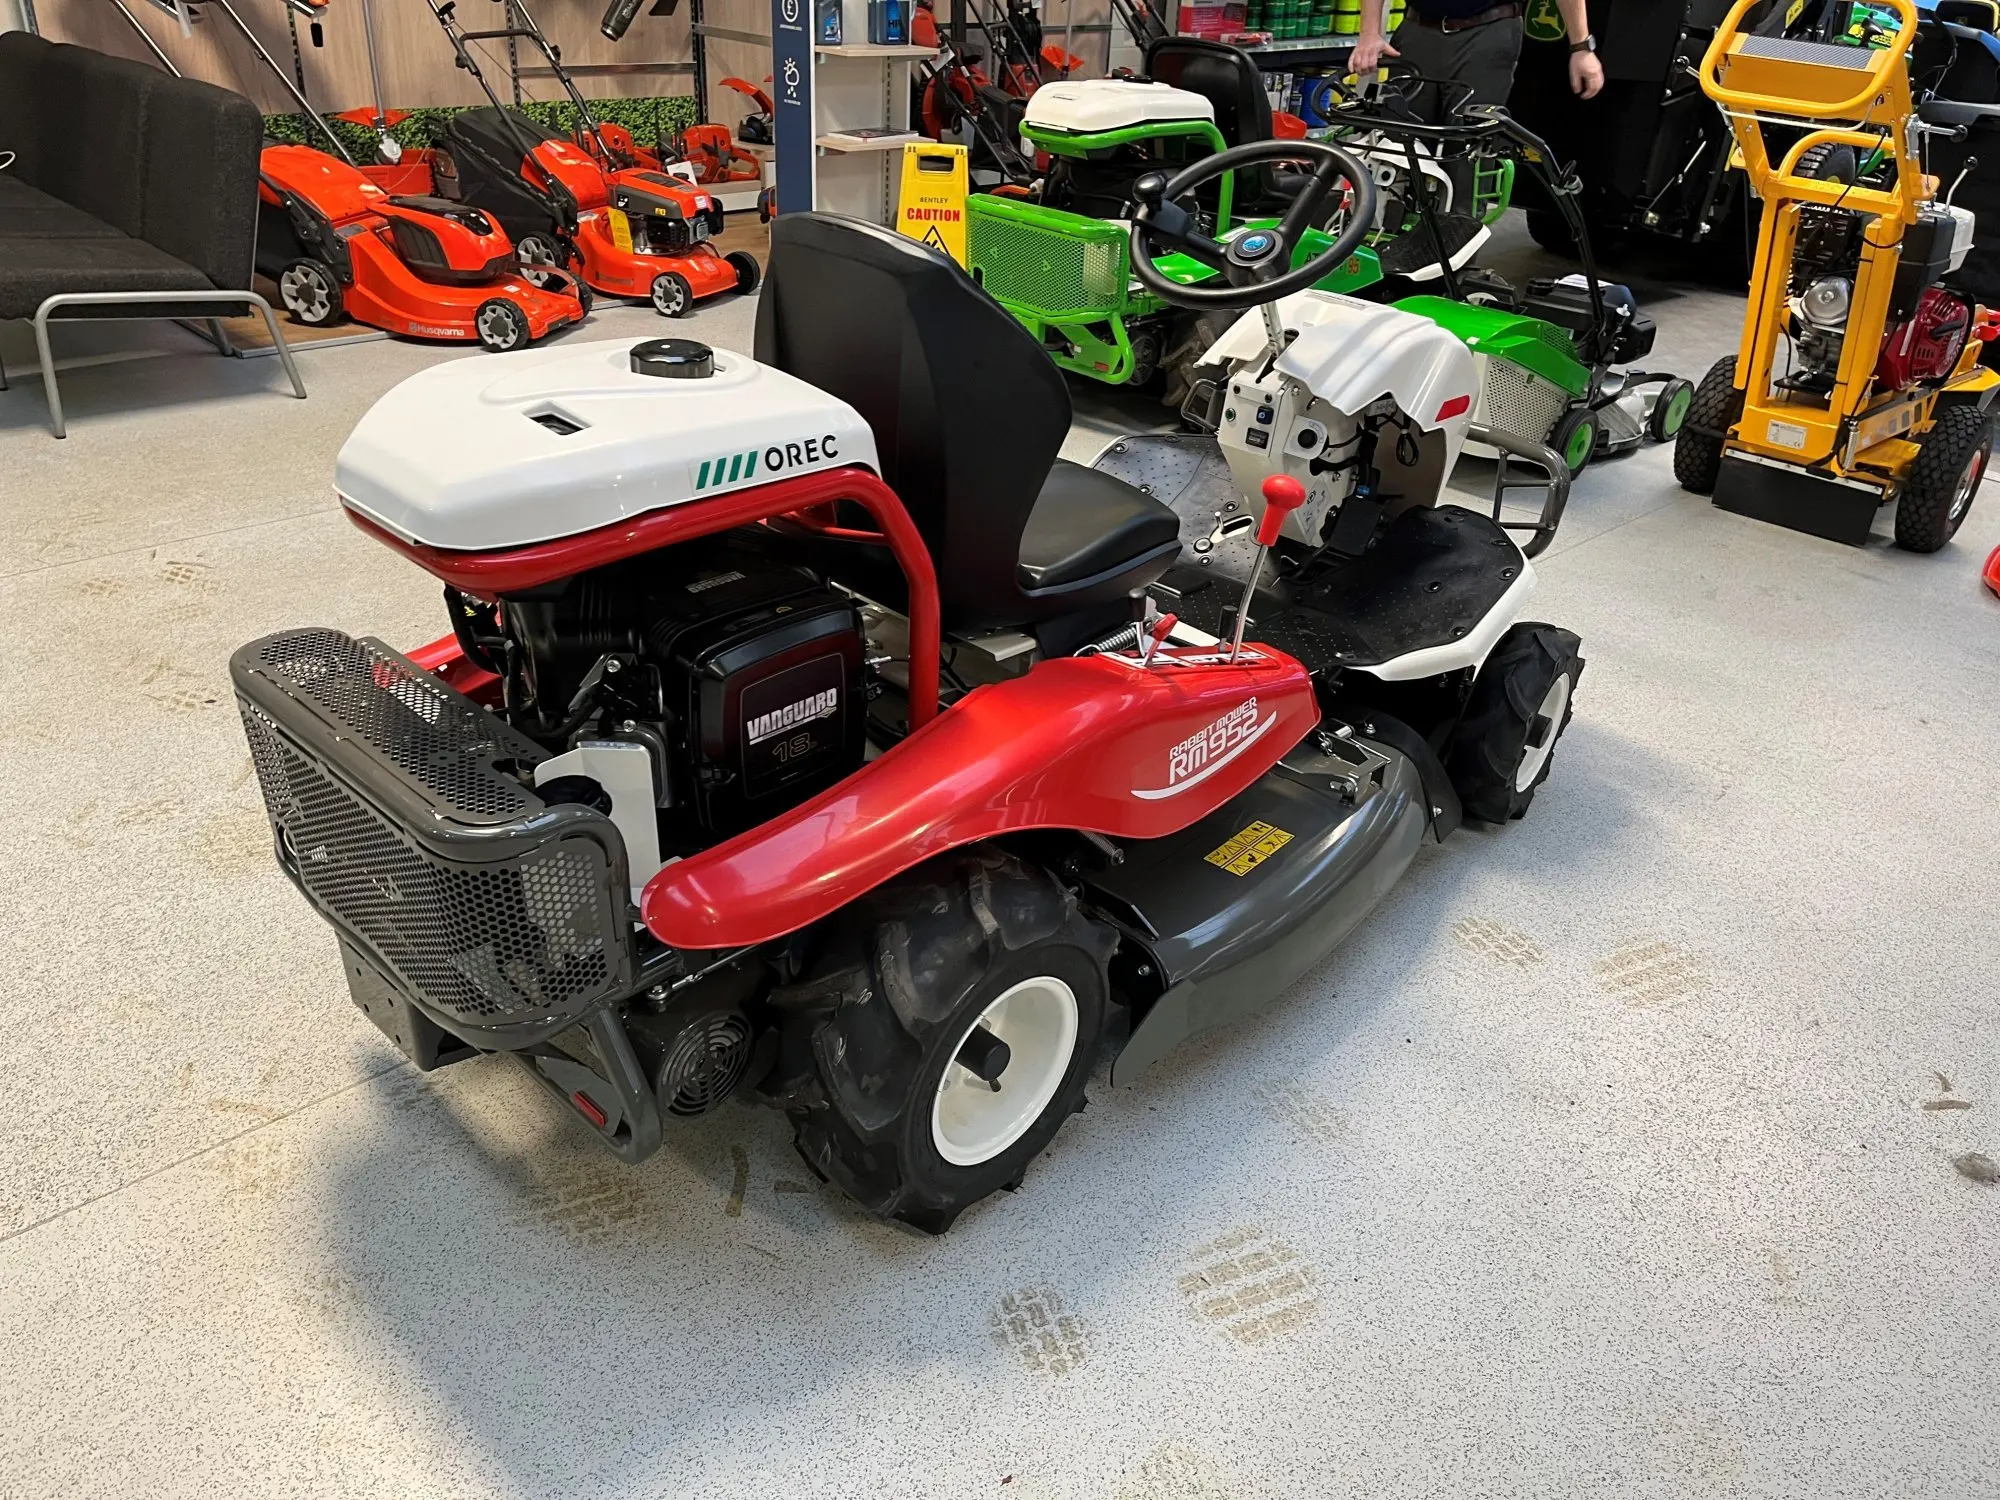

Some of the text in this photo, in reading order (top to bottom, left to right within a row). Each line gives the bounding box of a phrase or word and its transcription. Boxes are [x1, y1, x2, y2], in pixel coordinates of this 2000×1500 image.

[907, 208, 960, 222] CAUTION
[418, 323, 465, 336] Husqvarna
[765, 435, 839, 471] OREC
[747, 688, 837, 741] VANGUARD
[1170, 696, 1257, 760] RABBIT MOWER
